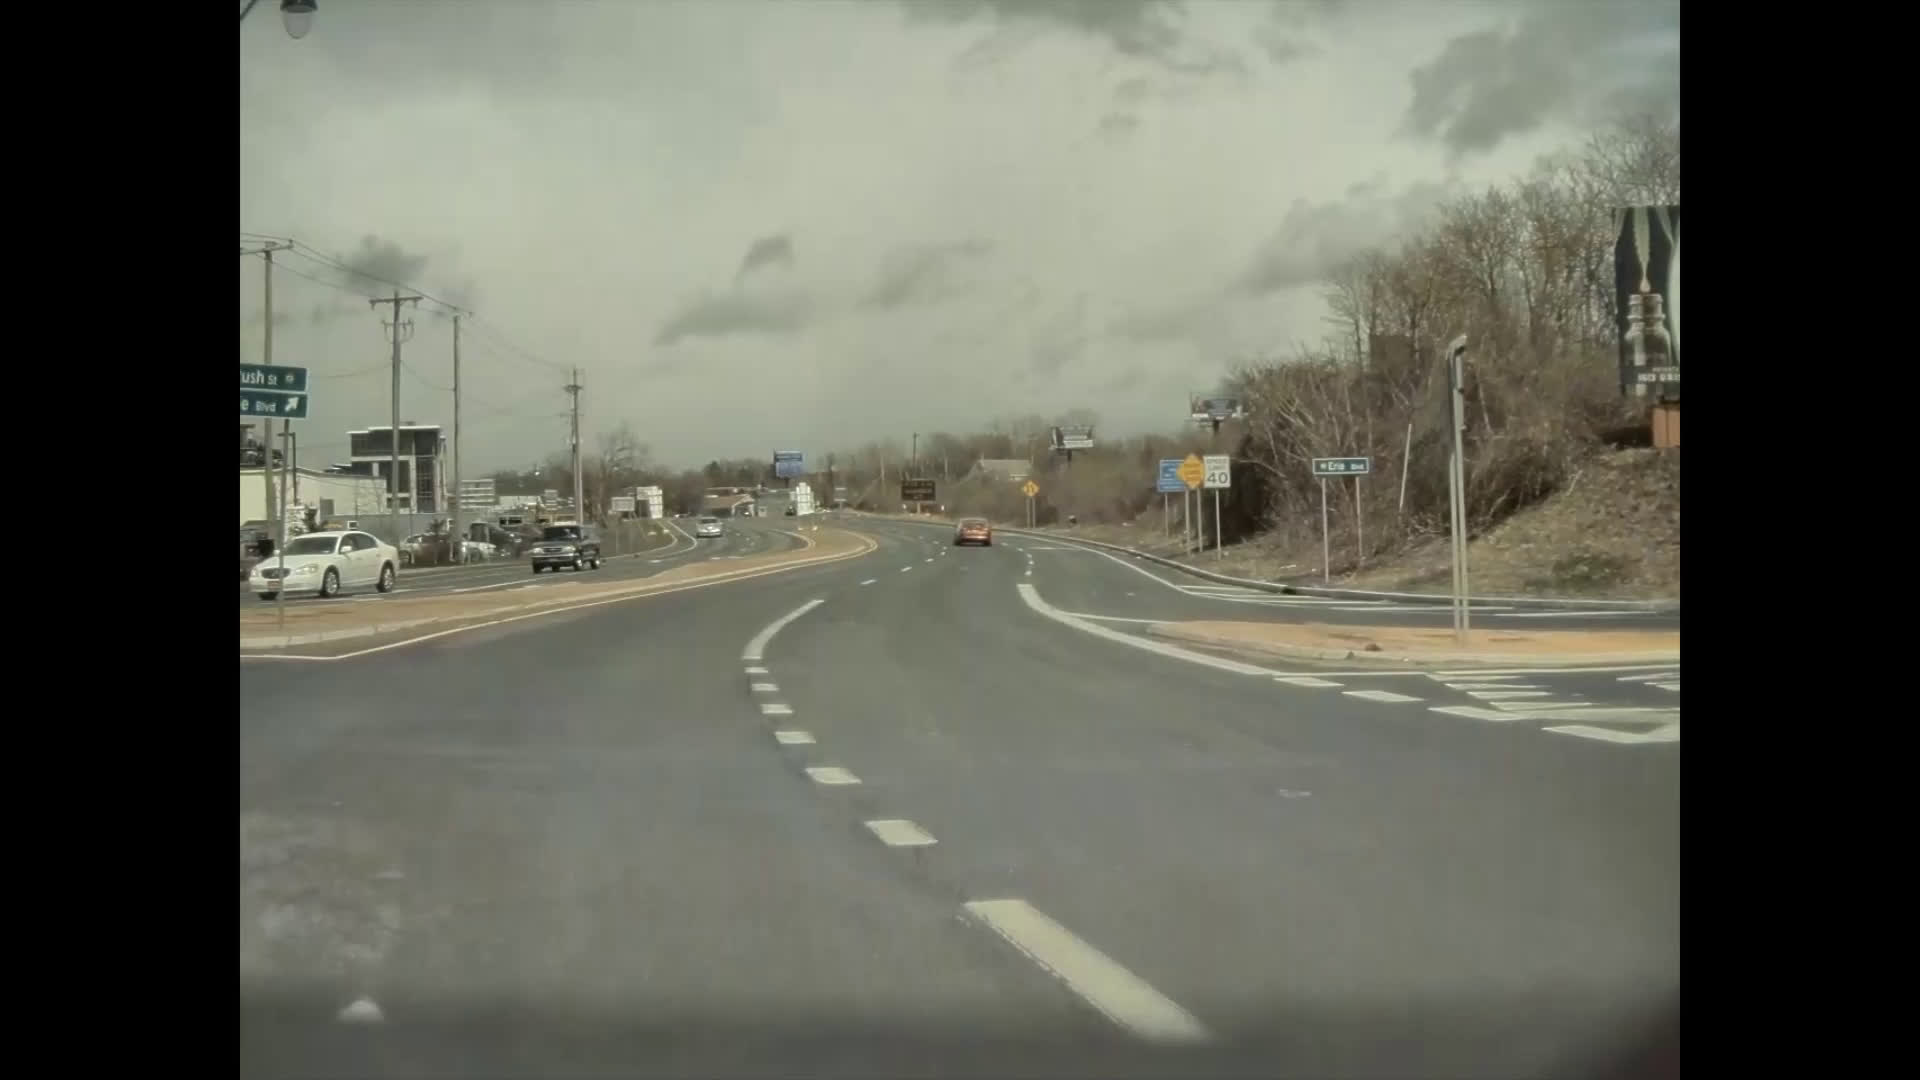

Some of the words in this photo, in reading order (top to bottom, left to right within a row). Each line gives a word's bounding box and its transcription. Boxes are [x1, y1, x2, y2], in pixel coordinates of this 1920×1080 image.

[240, 369, 264, 385] ush
[267, 374, 278, 386] St
[255, 400, 276, 412] Blvd
[1207, 471, 1228, 485] 40
